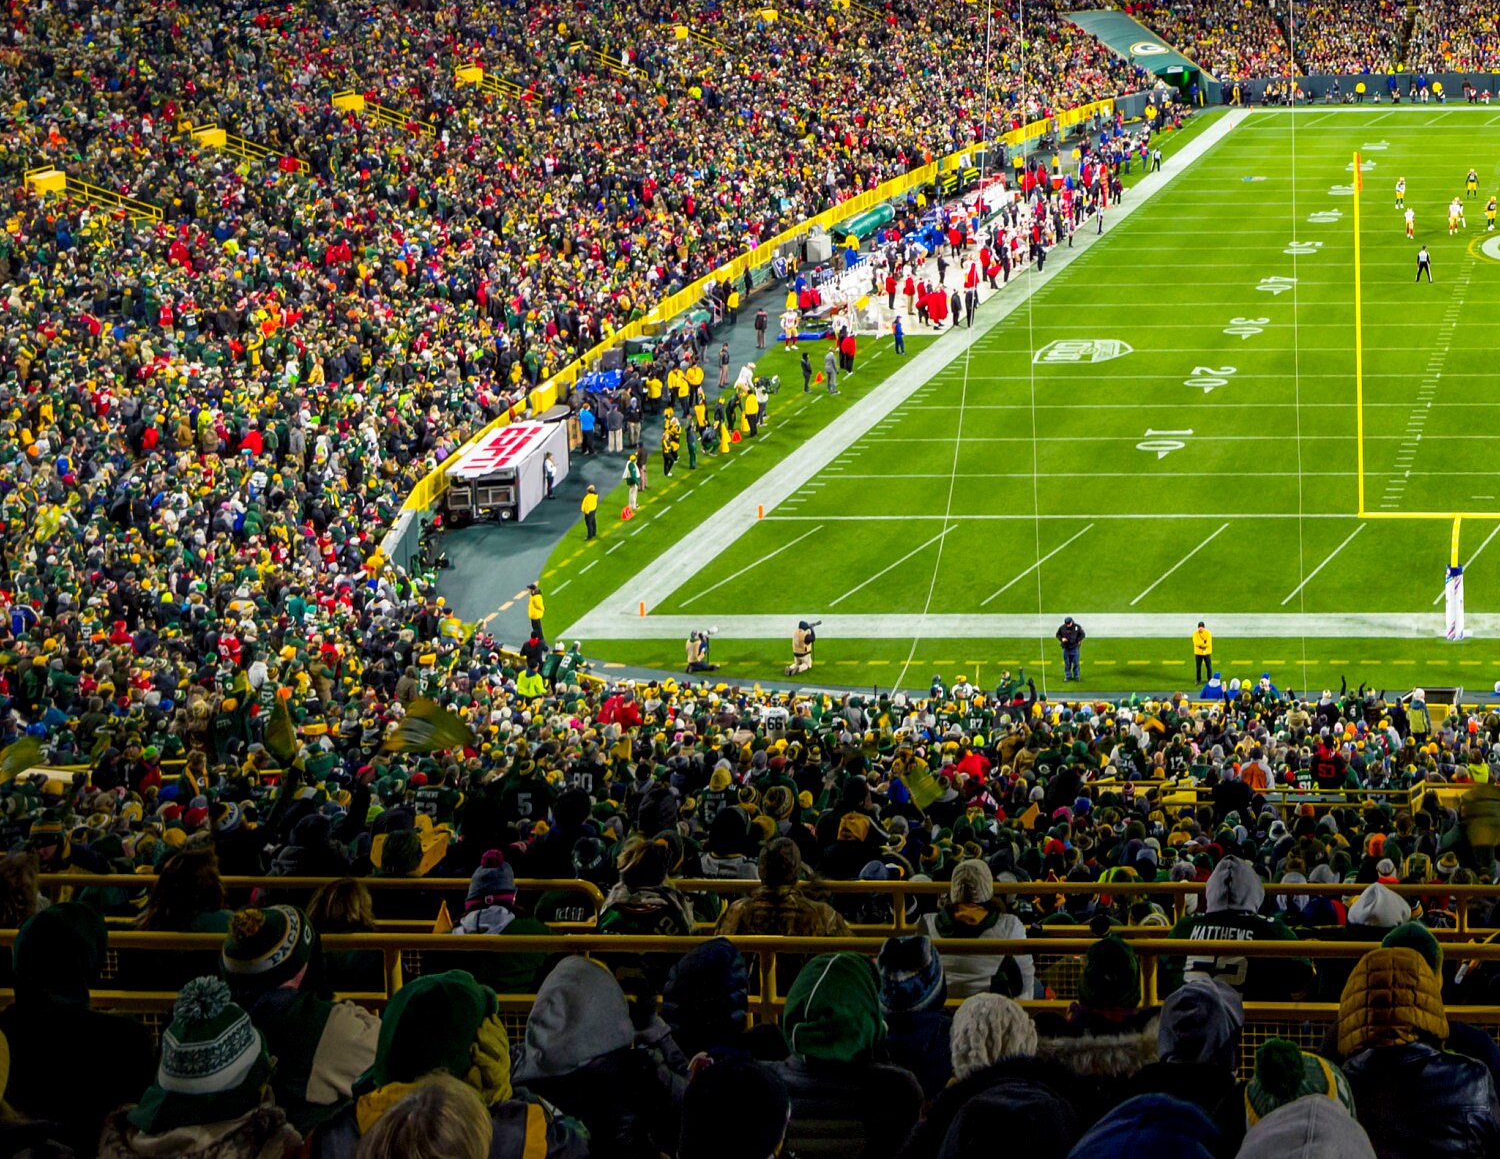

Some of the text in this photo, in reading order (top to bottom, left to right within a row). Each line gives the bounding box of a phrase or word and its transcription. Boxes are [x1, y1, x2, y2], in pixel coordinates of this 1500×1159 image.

[1222, 317, 1270, 335] 30
[1183, 366, 1237, 387] 20
[1136, 428, 1194, 451] 10
[767, 717, 783, 730] 66
[1317, 762, 1336, 778] 53
[517, 792, 533, 817] 5
[1189, 924, 1255, 941] MATTHEWS
